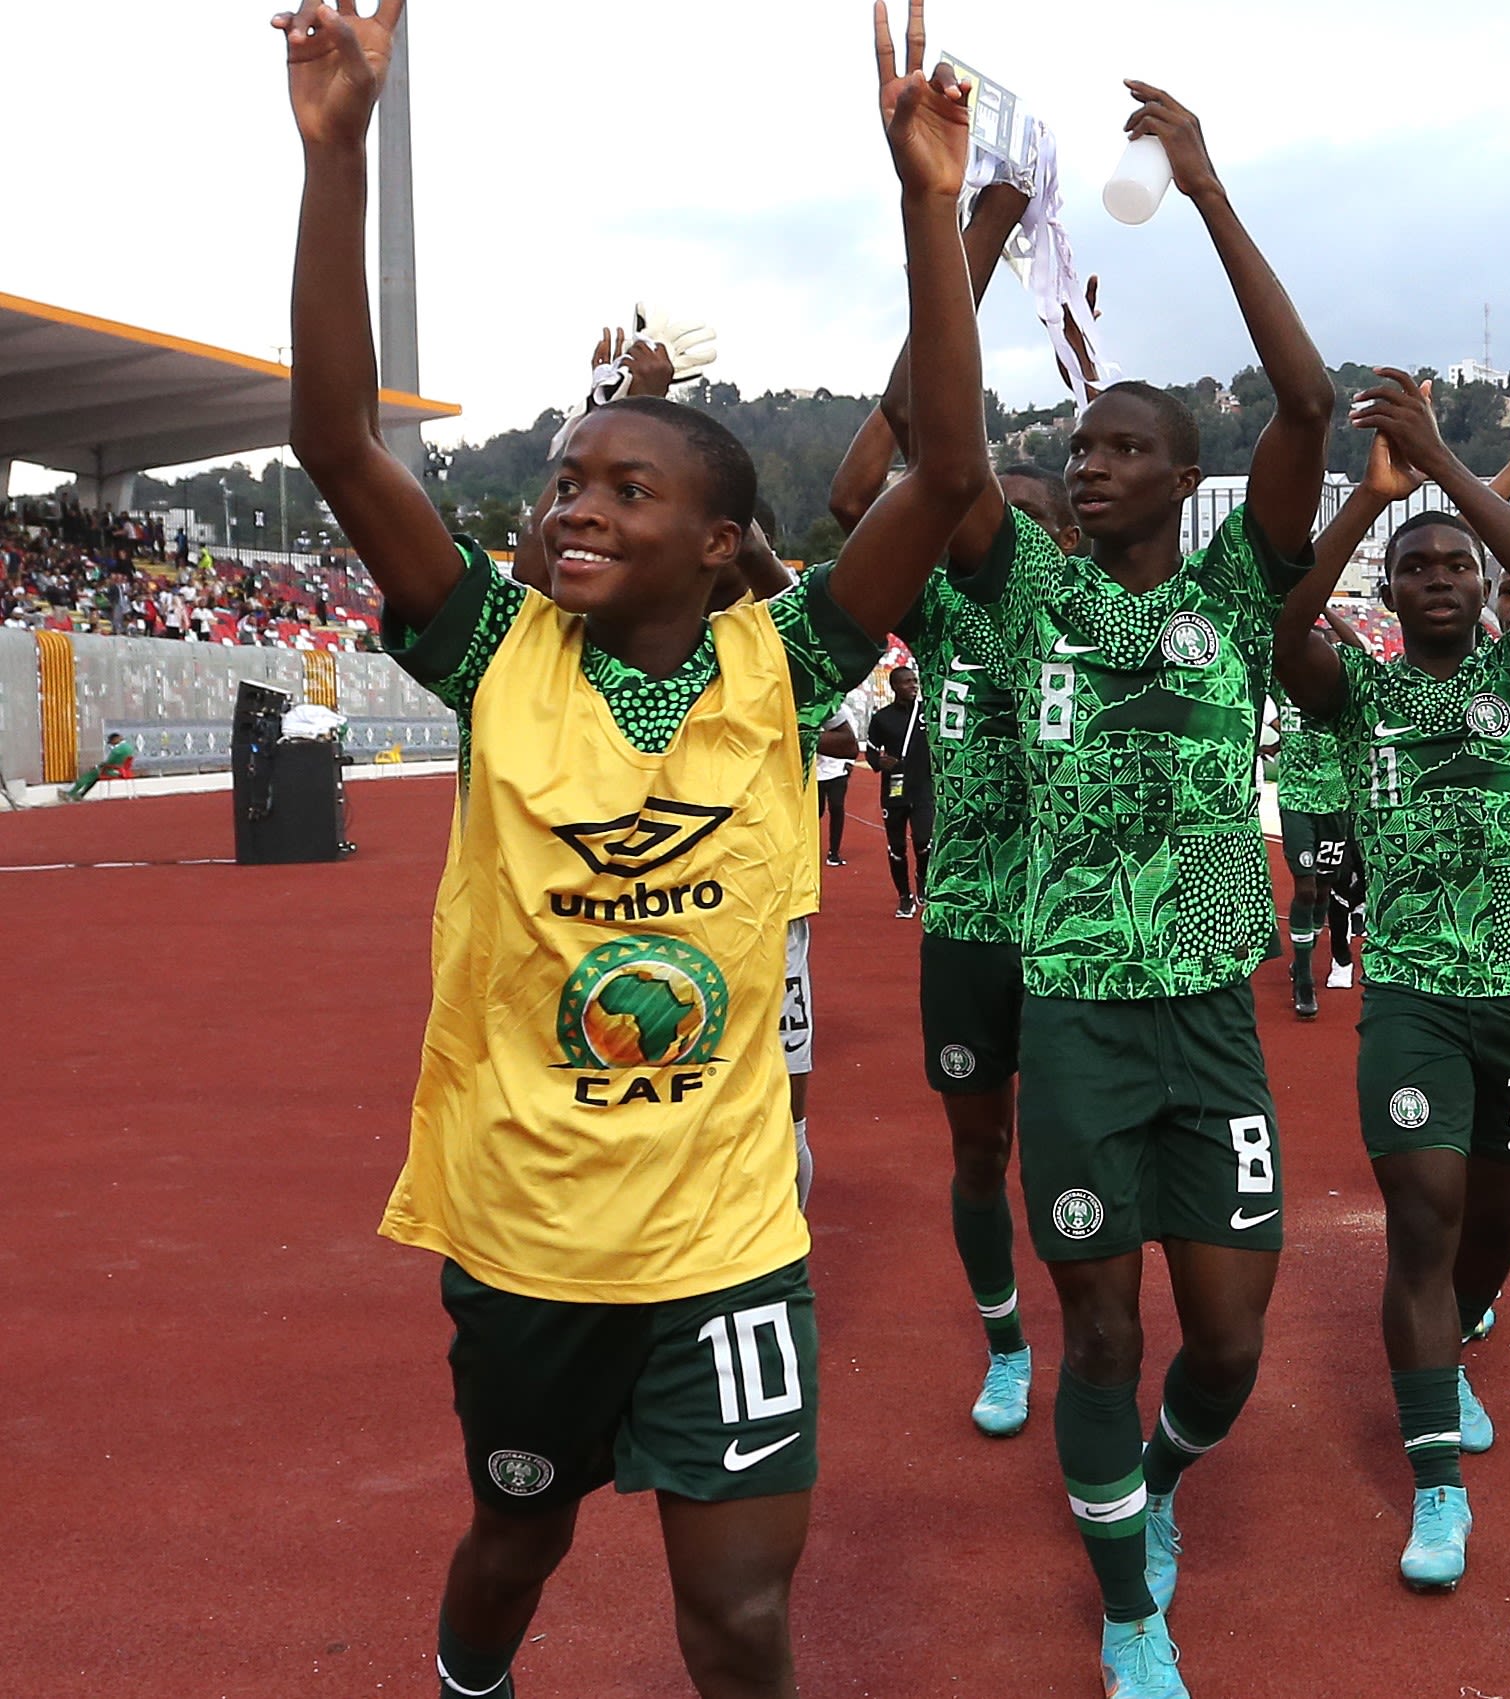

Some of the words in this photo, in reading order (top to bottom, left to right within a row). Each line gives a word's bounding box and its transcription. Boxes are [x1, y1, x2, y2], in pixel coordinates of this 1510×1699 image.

[940, 679, 970, 740] 6
[1040, 662, 1075, 740] 8
[1316, 841, 1346, 865] 25
[550, 879, 724, 922] umbro
[574, 1070, 704, 1108] CAF
[1228, 1114, 1274, 1194] 8
[697, 1300, 803, 1424] 10
